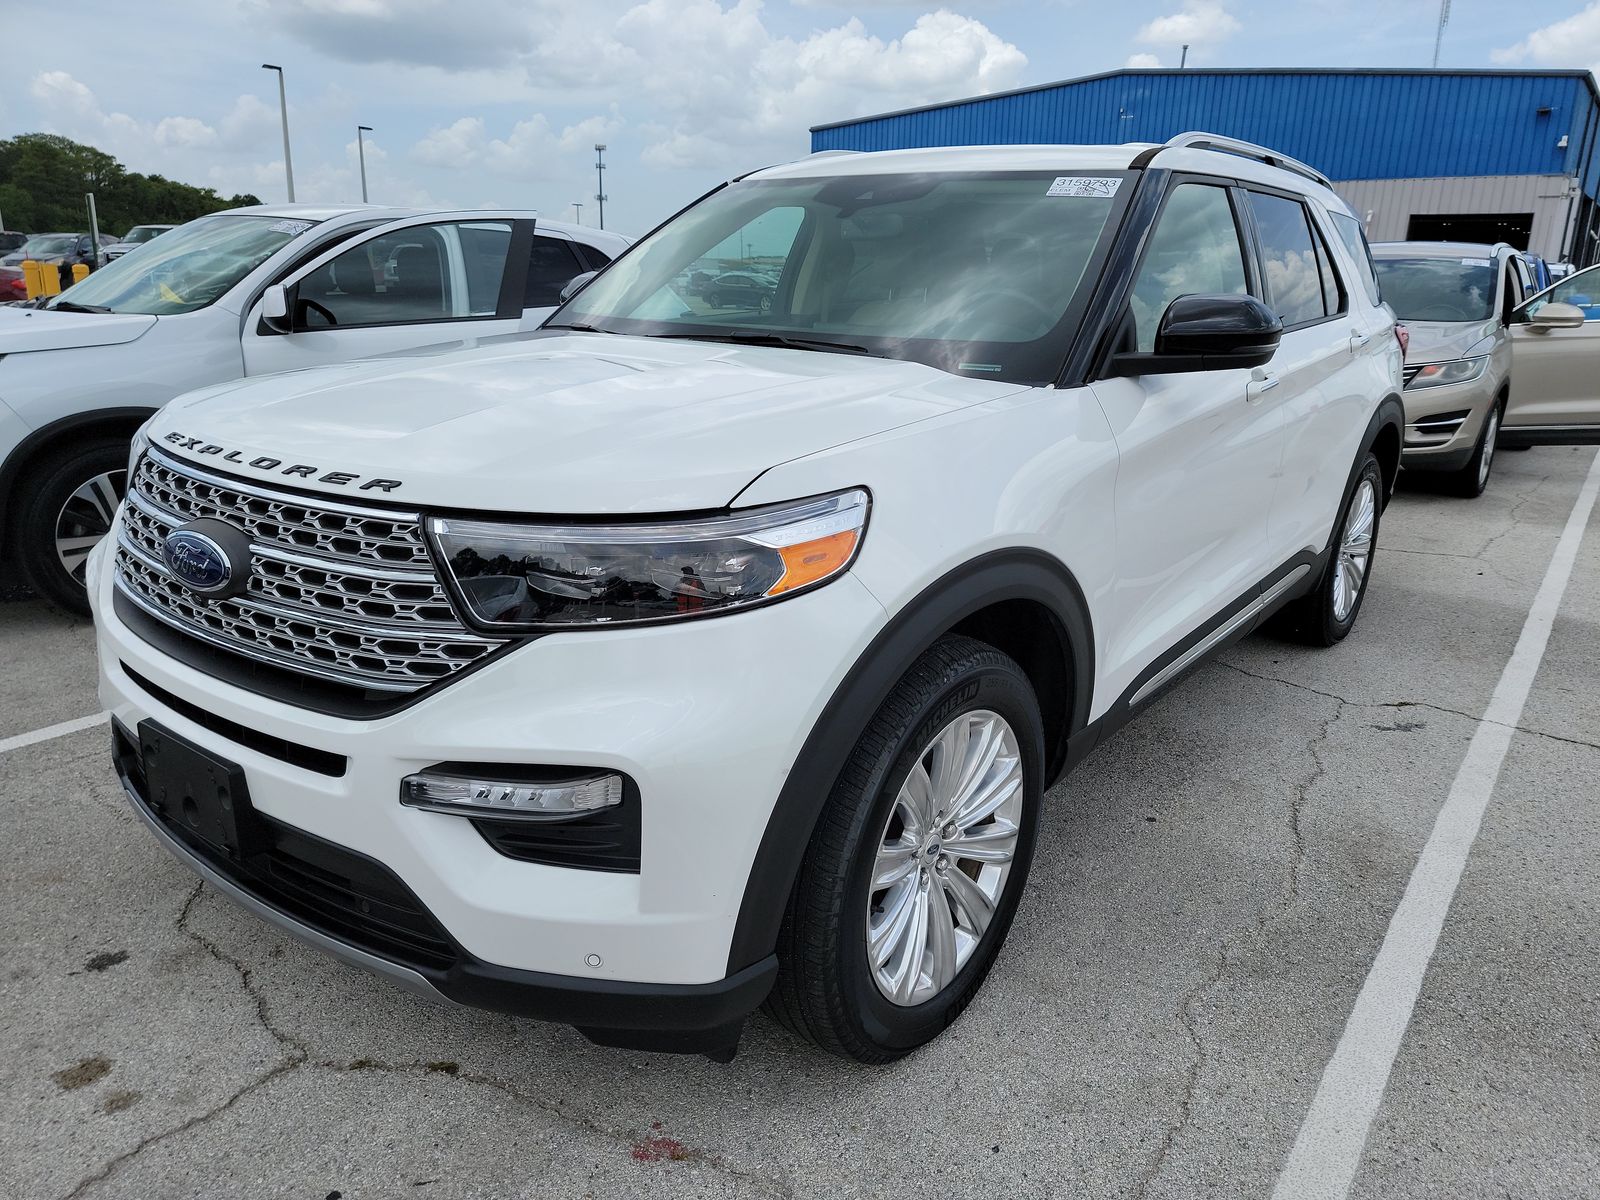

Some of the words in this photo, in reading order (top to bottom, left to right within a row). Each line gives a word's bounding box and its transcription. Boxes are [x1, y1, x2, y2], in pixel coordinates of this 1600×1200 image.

[1056, 178, 1117, 187] 3159793
[163, 431, 403, 493] EXPLORER
[171, 542, 210, 580] Ford
[916, 681, 978, 748] MICHELIN
